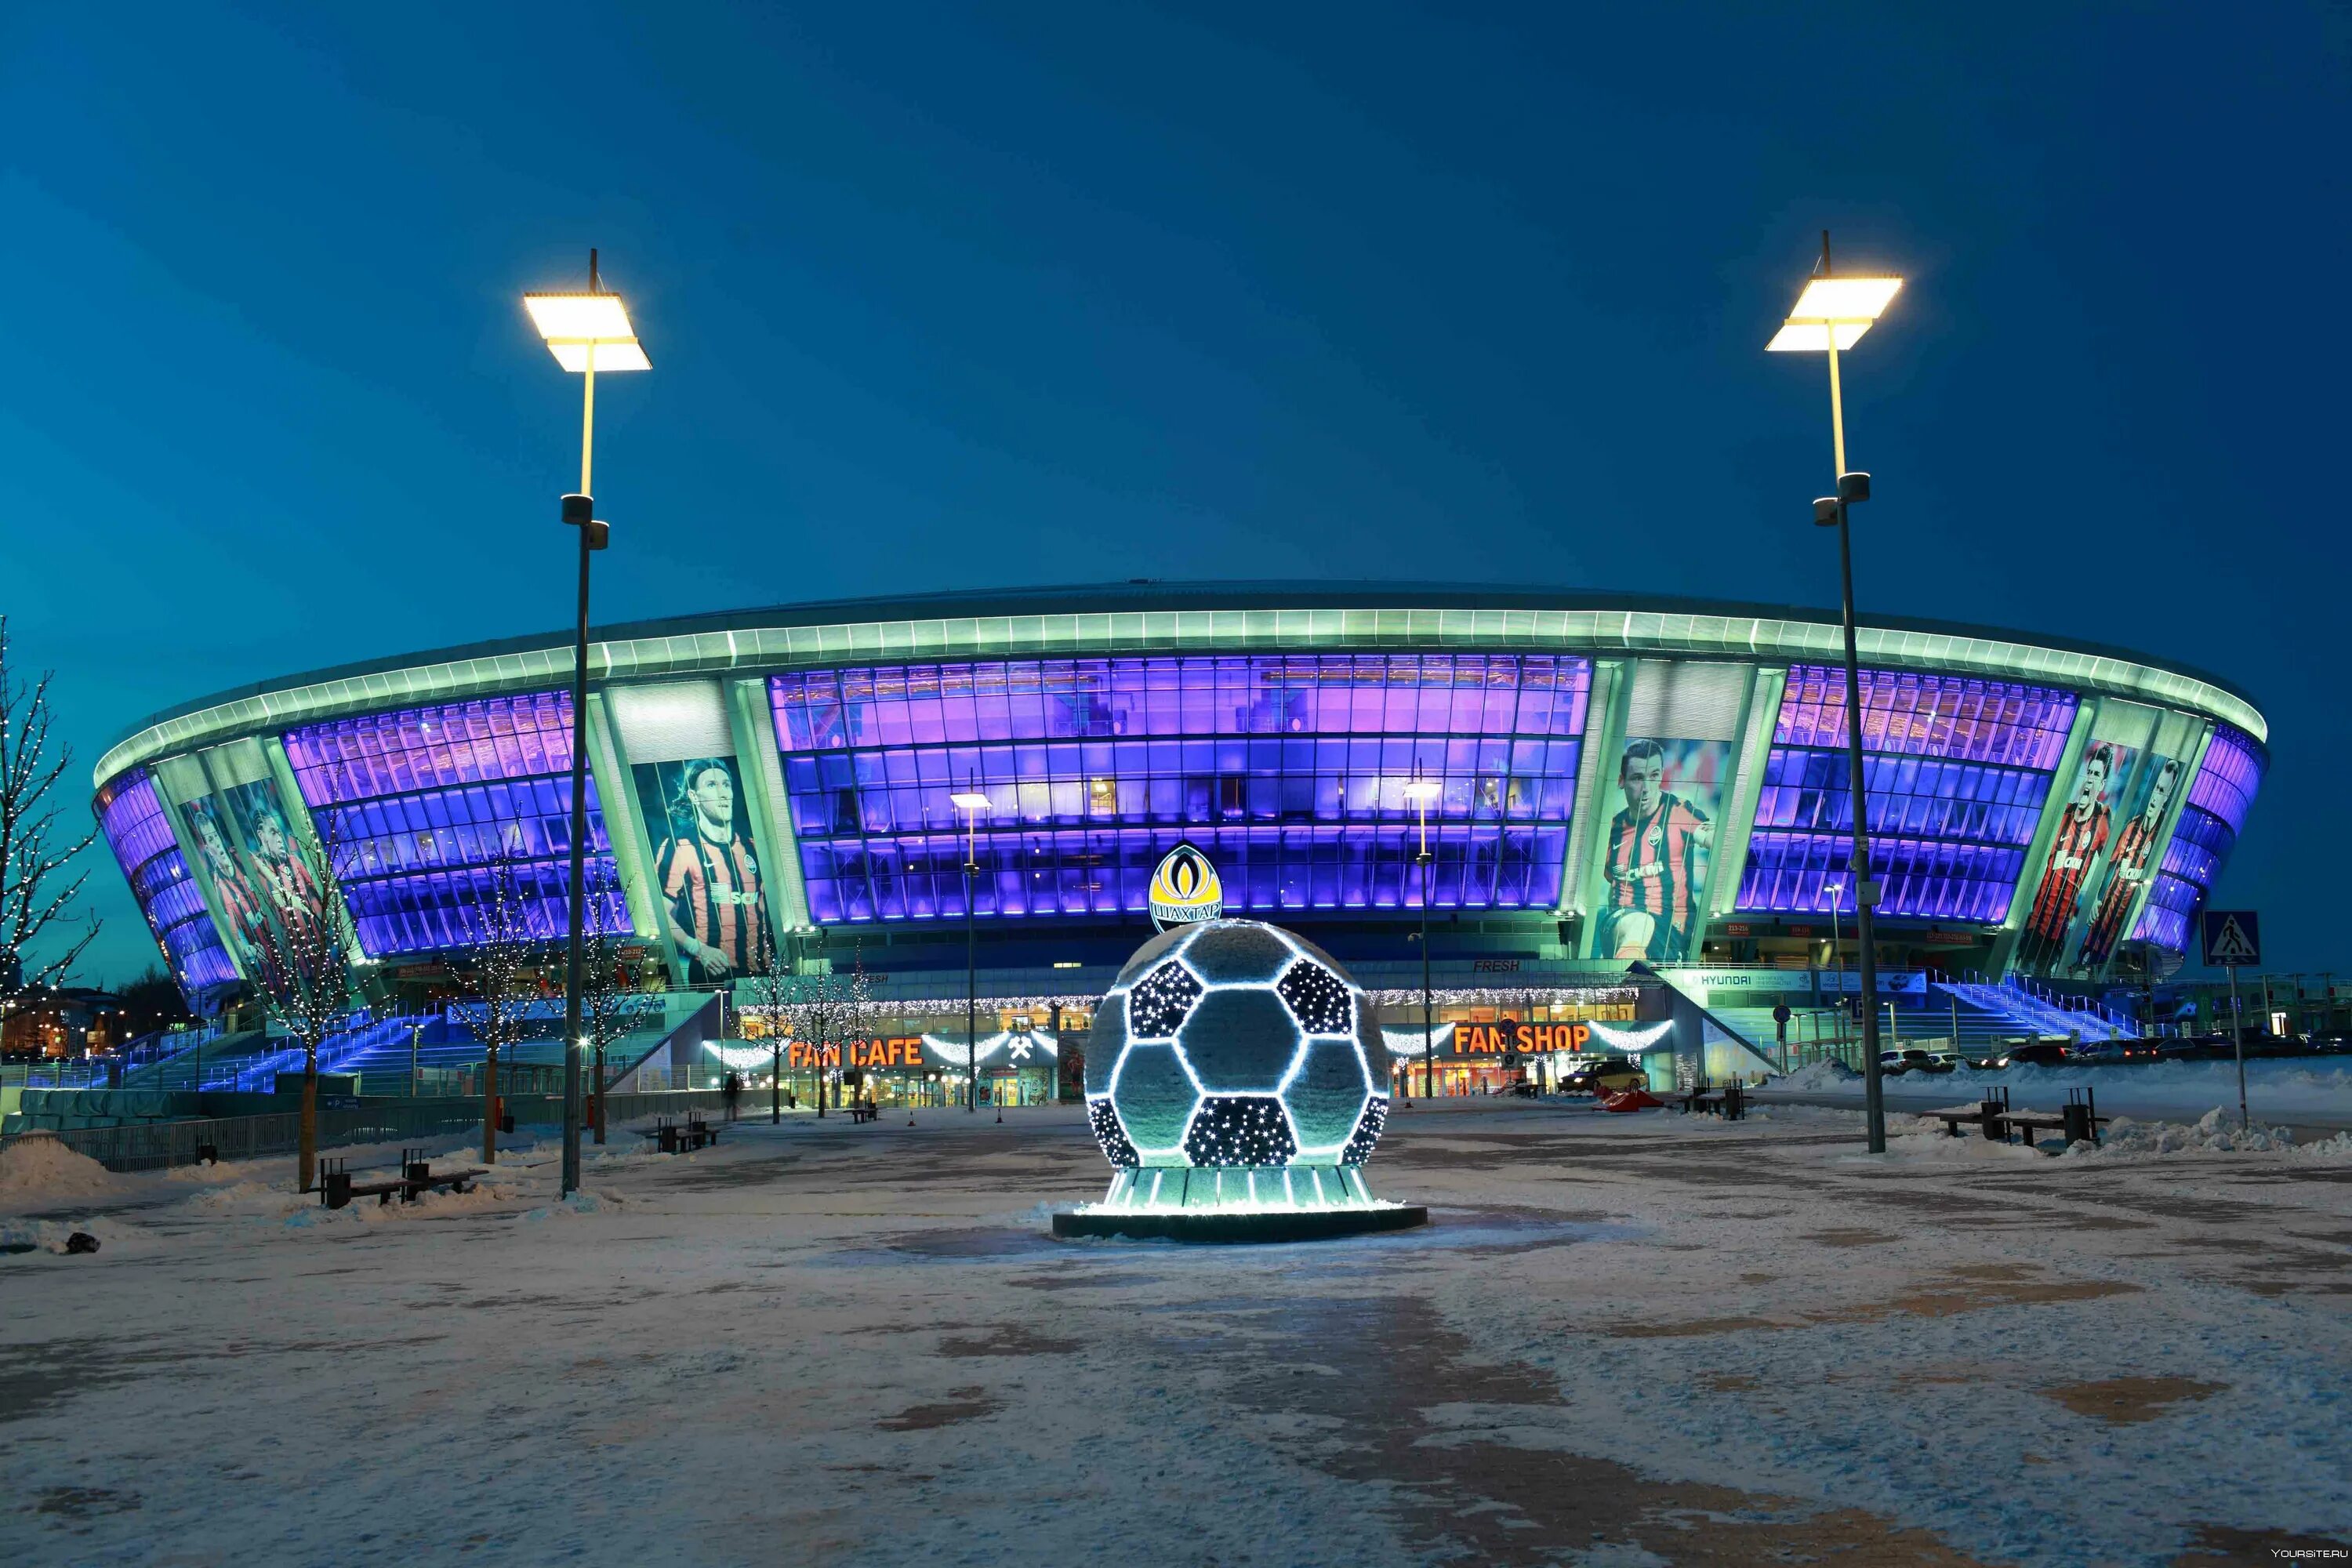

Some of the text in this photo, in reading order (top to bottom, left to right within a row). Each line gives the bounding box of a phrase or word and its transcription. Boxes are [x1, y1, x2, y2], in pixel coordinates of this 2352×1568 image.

[1154, 904, 1219, 920] ШАХТАР
[1474, 960, 1519, 972] FRESH
[1701, 975, 1751, 985] HYUNDAI
[1454, 1025, 1590, 1054] FAN SHOP
[789, 1037, 923, 1067] FAN CAFE
